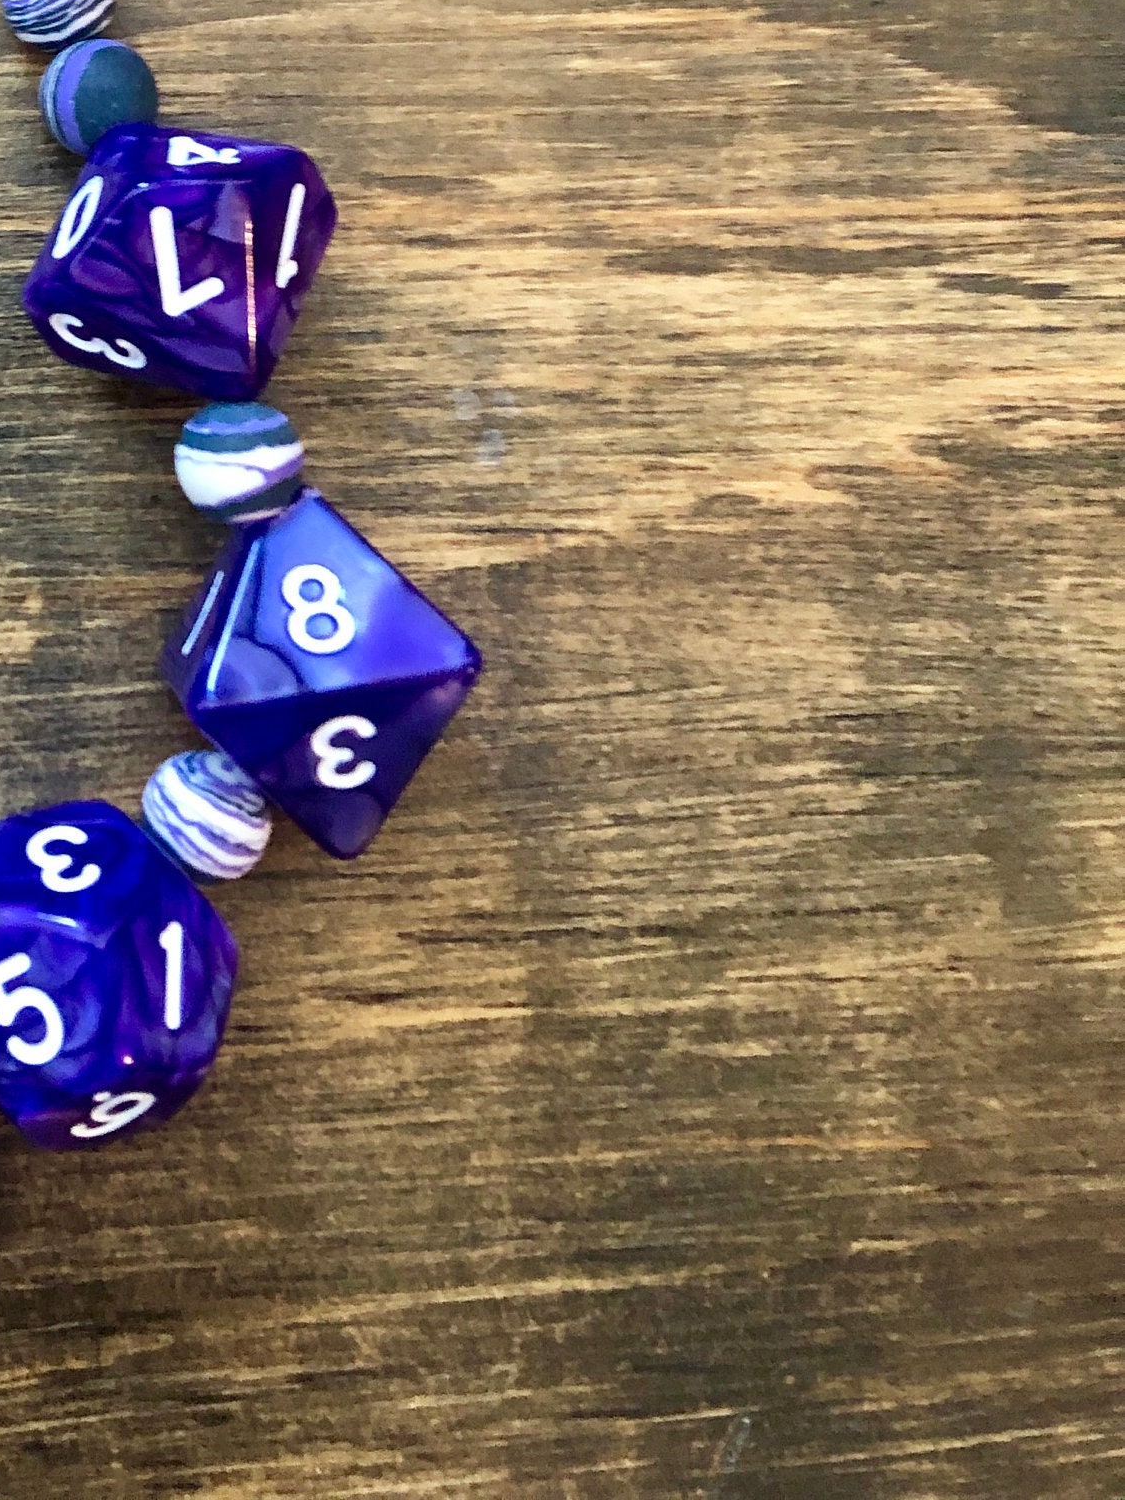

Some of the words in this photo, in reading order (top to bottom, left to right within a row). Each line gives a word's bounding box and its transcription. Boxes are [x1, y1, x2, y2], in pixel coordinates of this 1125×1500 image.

[165, 134, 243, 168] 4
[51, 175, 104, 260] 0
[148, 205, 226, 318] 7
[48, 312, 148, 370] 3
[281, 563, 357, 655] 8
[308, 714, 378, 790] 3
[24, 824, 102, 894] 3
[158, 920, 184, 1031] 1
